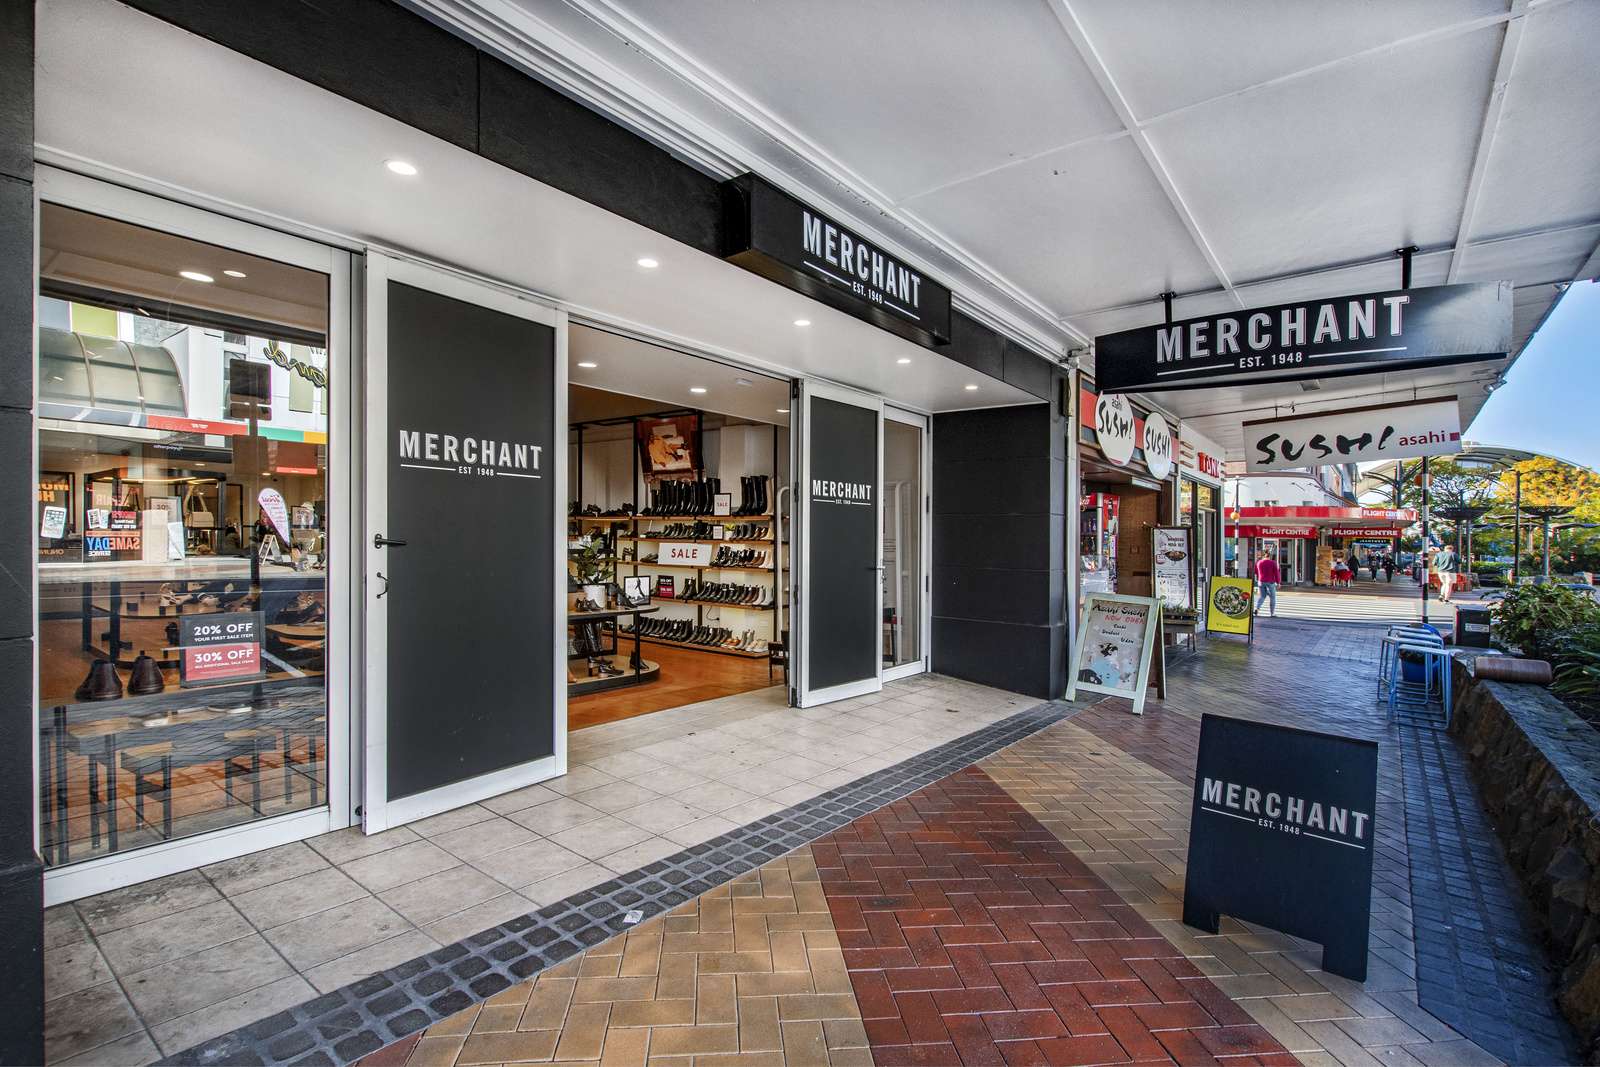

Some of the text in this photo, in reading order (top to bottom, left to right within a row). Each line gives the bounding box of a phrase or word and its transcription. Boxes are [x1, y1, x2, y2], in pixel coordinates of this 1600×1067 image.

[803, 211, 921, 308] MERCHANT
[853, 281, 883, 304] EST. 1948
[1156, 295, 1410, 364] MERCHANT
[1239, 351, 1303, 369] EST. 1948
[1145, 426, 1170, 459] SUSHI
[1399, 430, 1446, 446] asahi
[399, 429, 543, 470] MERCHANT
[477, 467, 494, 477] 1948
[812, 479, 872, 500] MERCHANT
[671, 548, 698, 559] SALE
[193, 623, 254, 636] 20% OFF
[194, 648, 254, 663] 30% OFF
[1201, 777, 1369, 840] MERCHANT
[1258, 818, 1301, 835] EST. 1948
